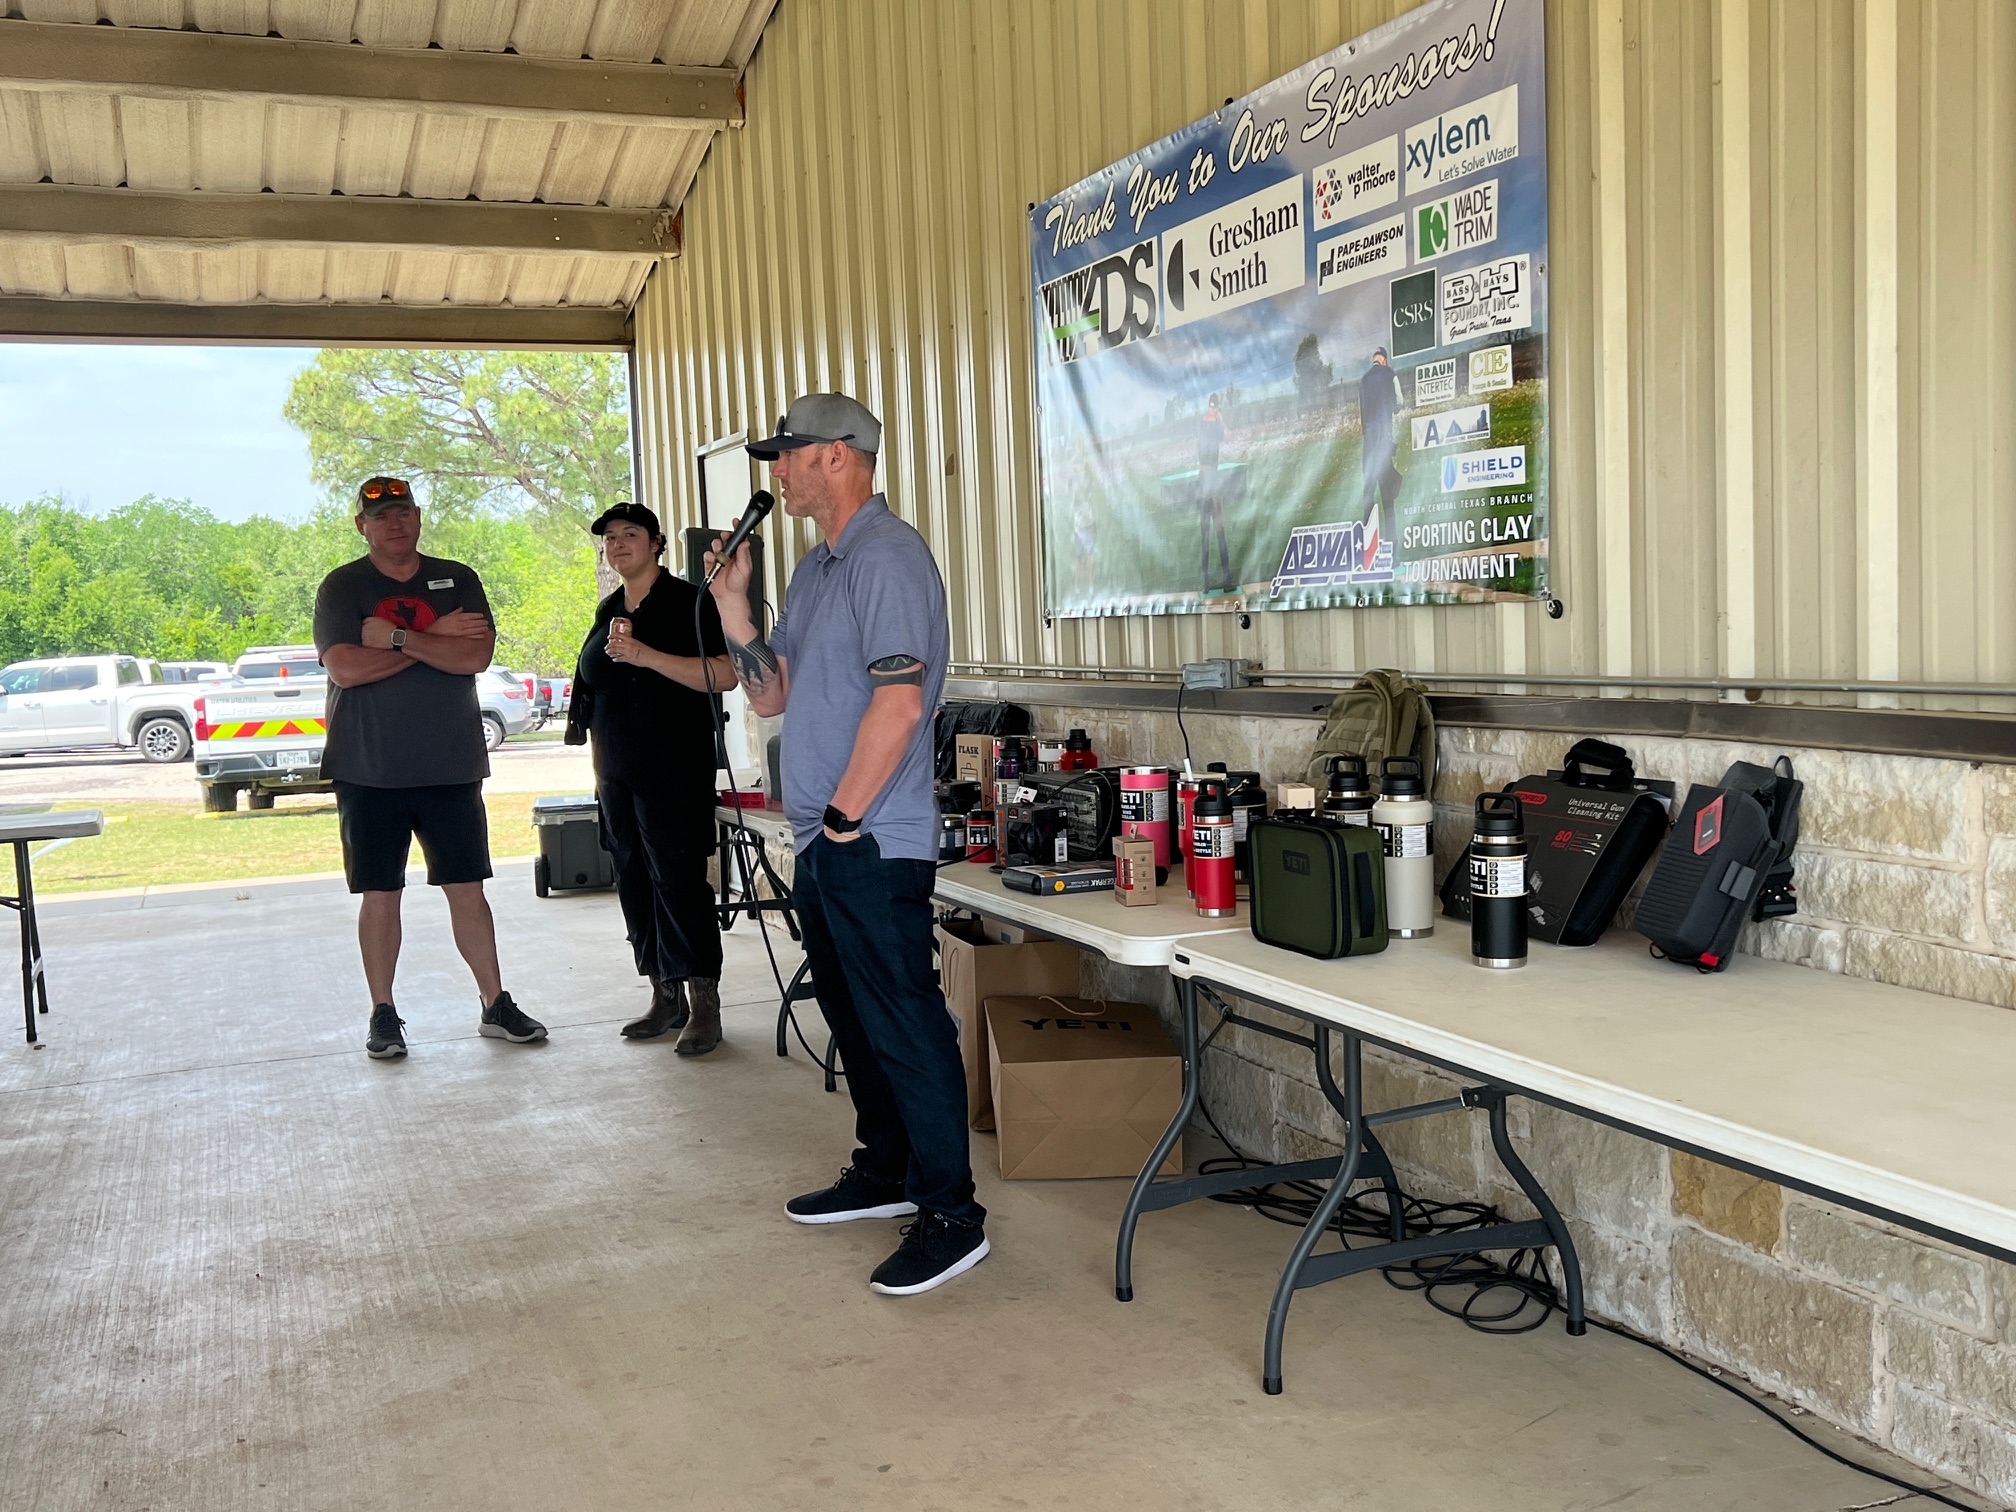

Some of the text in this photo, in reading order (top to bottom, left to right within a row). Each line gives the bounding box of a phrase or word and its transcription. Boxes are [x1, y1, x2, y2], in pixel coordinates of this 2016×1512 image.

[1045, 0, 1503, 258] Thank You to Our Sponsors!
[1406, 114, 1490, 179] xylem
[1347, 162, 1382, 186] walter
[1438, 145, 1517, 183] Let's Solve Water
[1353, 169, 1396, 199] p moore
[1454, 185, 1493, 221] WADE
[1209, 202, 1299, 259] Gresham
[1337, 224, 1404, 259] PAPE-DAWSON
[1454, 212, 1493, 248] TRIM
[1336, 245, 1387, 274] ENGINEERS
[1210, 252, 1268, 302] Smith
[1446, 285, 1470, 299] BASS
[1483, 274, 1510, 288] HAYS
[1393, 299, 1433, 328] CSRS
[1417, 361, 1454, 381] BRAUN
[1471, 349, 1508, 378] CIE
[1417, 378, 1454, 396] INTERTEC
[1461, 456, 1523, 475] SHIELD
[1467, 471, 1515, 483] ENGINEERING
[1403, 493, 1534, 516] NORTH CENTRAL TEXAS BRANCH
[1403, 514, 1533, 549] SPORTING CLAY
[1279, 530, 1352, 576] APWA
[1403, 553, 1519, 583] TOURNAMENT
[958, 745, 979, 755] FLASK
[1121, 792, 1140, 804] ETI
[1568, 798, 1625, 813] Universal Gun
[1567, 806, 1621, 821] Cleaning Kit
[1193, 830, 1211, 841] ETI
[1554, 829, 1574, 843] 80
[1283, 854, 1310, 872] YETI
[1020, 1017, 1133, 1032] YETI
